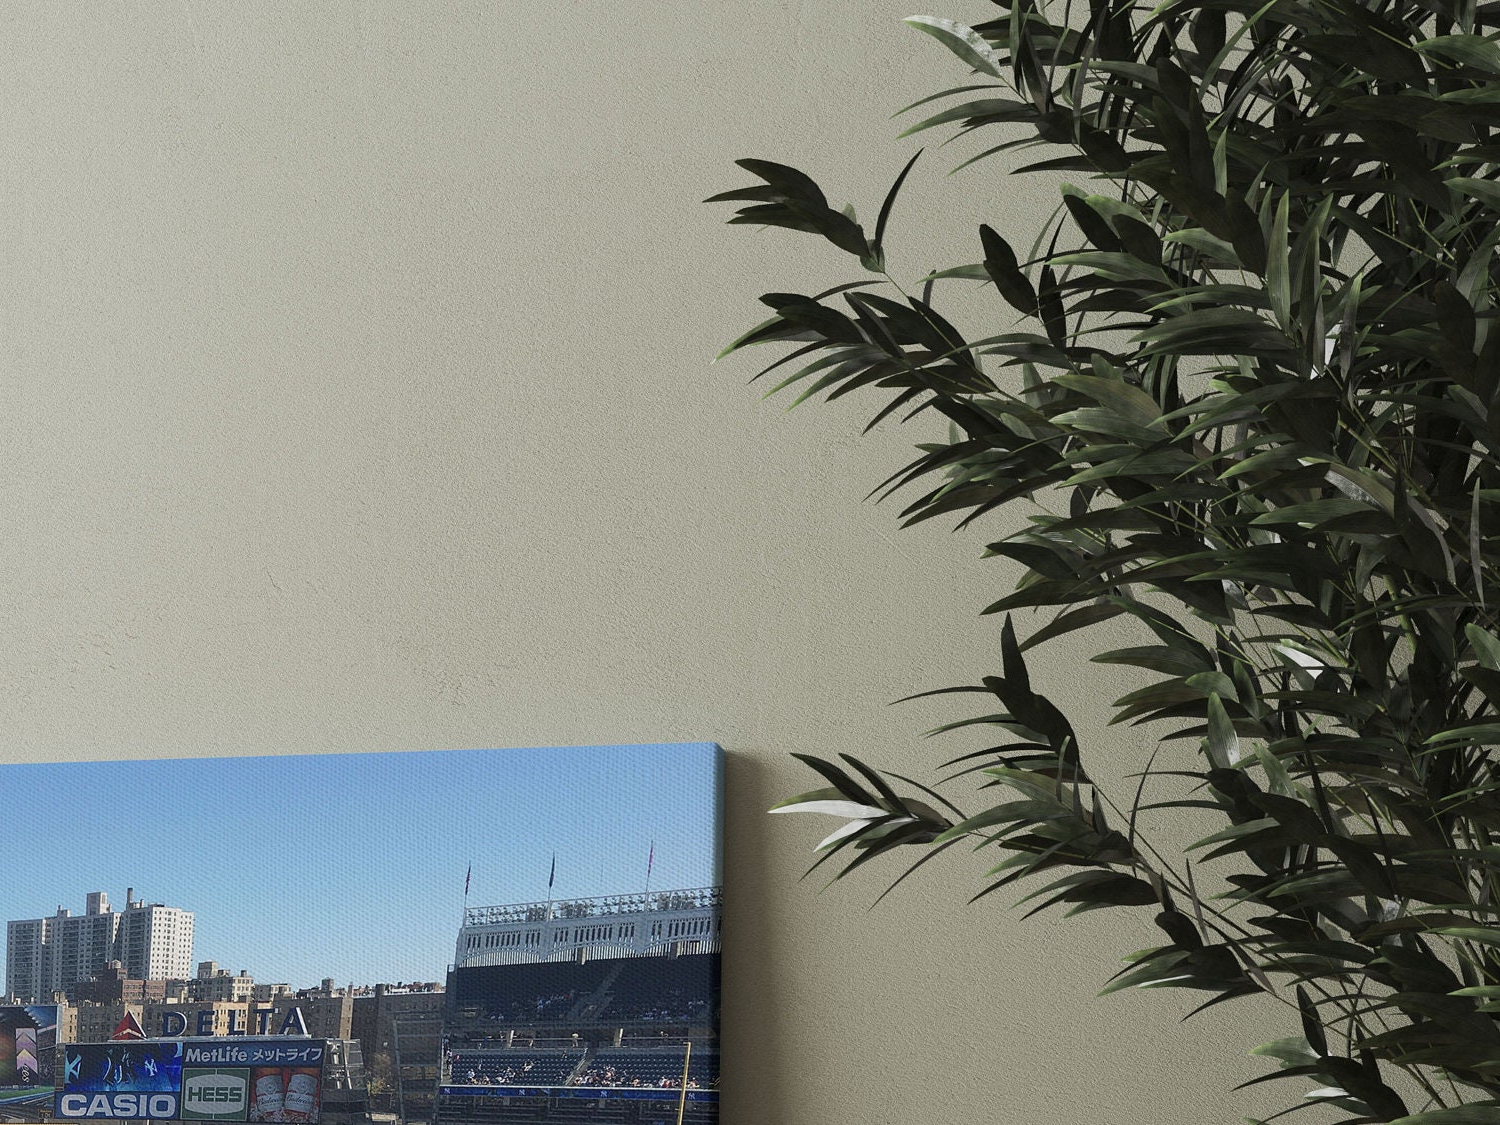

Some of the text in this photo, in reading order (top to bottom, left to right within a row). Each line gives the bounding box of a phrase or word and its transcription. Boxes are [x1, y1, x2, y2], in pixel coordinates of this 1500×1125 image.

[162, 1007, 309, 1037] DELTA
[185, 1046, 247, 1062] MetLife
[252, 1047, 322, 1061] メットライフ
[188, 1086, 243, 1102] HESS
[61, 1094, 176, 1117] CASIO
